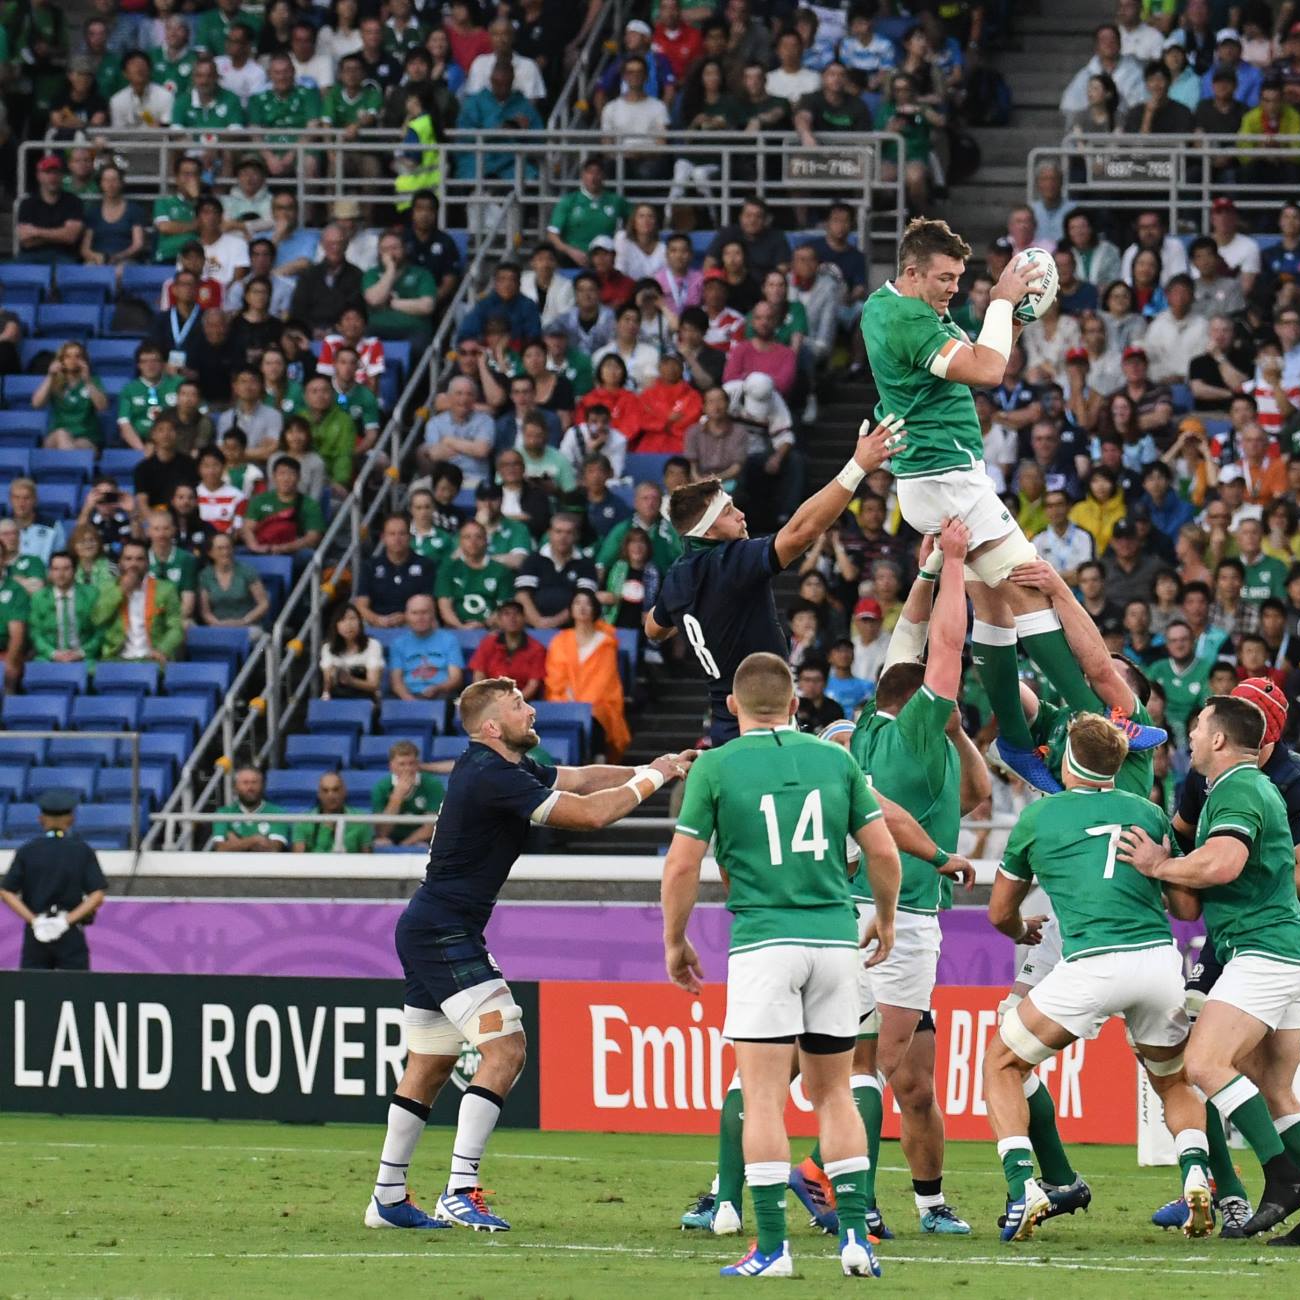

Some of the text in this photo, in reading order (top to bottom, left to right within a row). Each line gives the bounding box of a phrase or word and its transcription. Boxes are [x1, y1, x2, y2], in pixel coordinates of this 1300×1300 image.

[1034, 263, 1054, 305] GILBET
[683, 613, 721, 679] 8
[759, 788, 829, 866] 14
[1084, 824, 1122, 878] 7
[14, 999, 408, 1097] LAND ROVER
[588, 1001, 814, 1111] Emir
[945, 1009, 1085, 1118] BER
